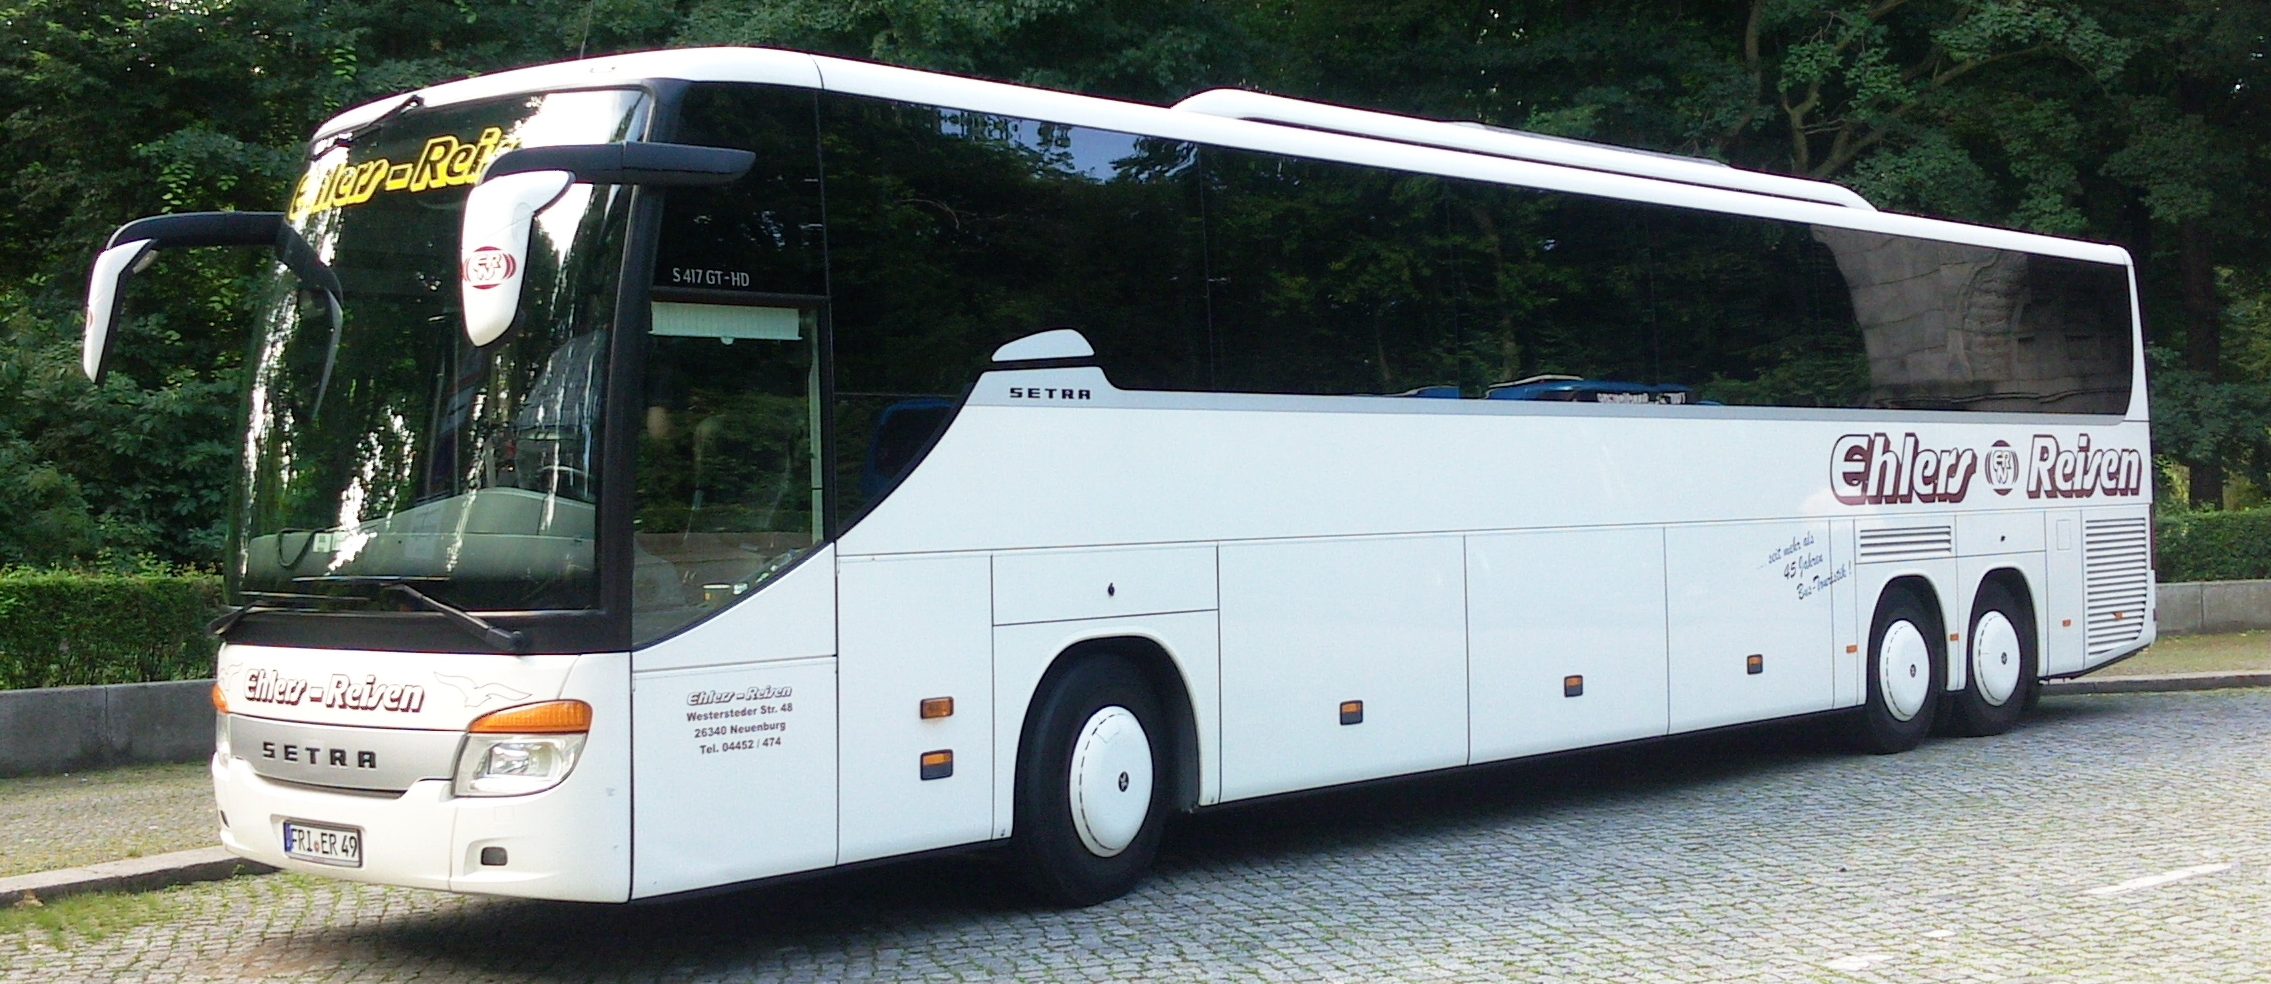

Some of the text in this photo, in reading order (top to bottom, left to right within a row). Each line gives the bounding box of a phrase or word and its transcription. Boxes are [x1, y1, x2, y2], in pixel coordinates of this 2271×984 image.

[672, 267, 750, 287] S 417 GT-HD
[1009, 387, 1091, 400] SETRA
[1830, 432, 1977, 505] Ehlers
[2027, 433, 2142, 499] Reisen
[1784, 560, 1796, 580] 45
[244, 669, 308, 705] Ehlers
[326, 673, 426, 713] Reisen
[687, 690, 735, 706] Ehlers
[745, 685, 793, 701] Reisen
[687, 703, 793, 721] Westersteder Str. 48
[694, 722, 787, 738] 26340 Neuenburg
[262, 741, 377, 769] SETRA
[700, 744, 720, 754] Tel.
[722, 740, 754, 752] 04452
[762, 737, 782, 747] 474
[290, 828, 358, 858] FRI ER 49
